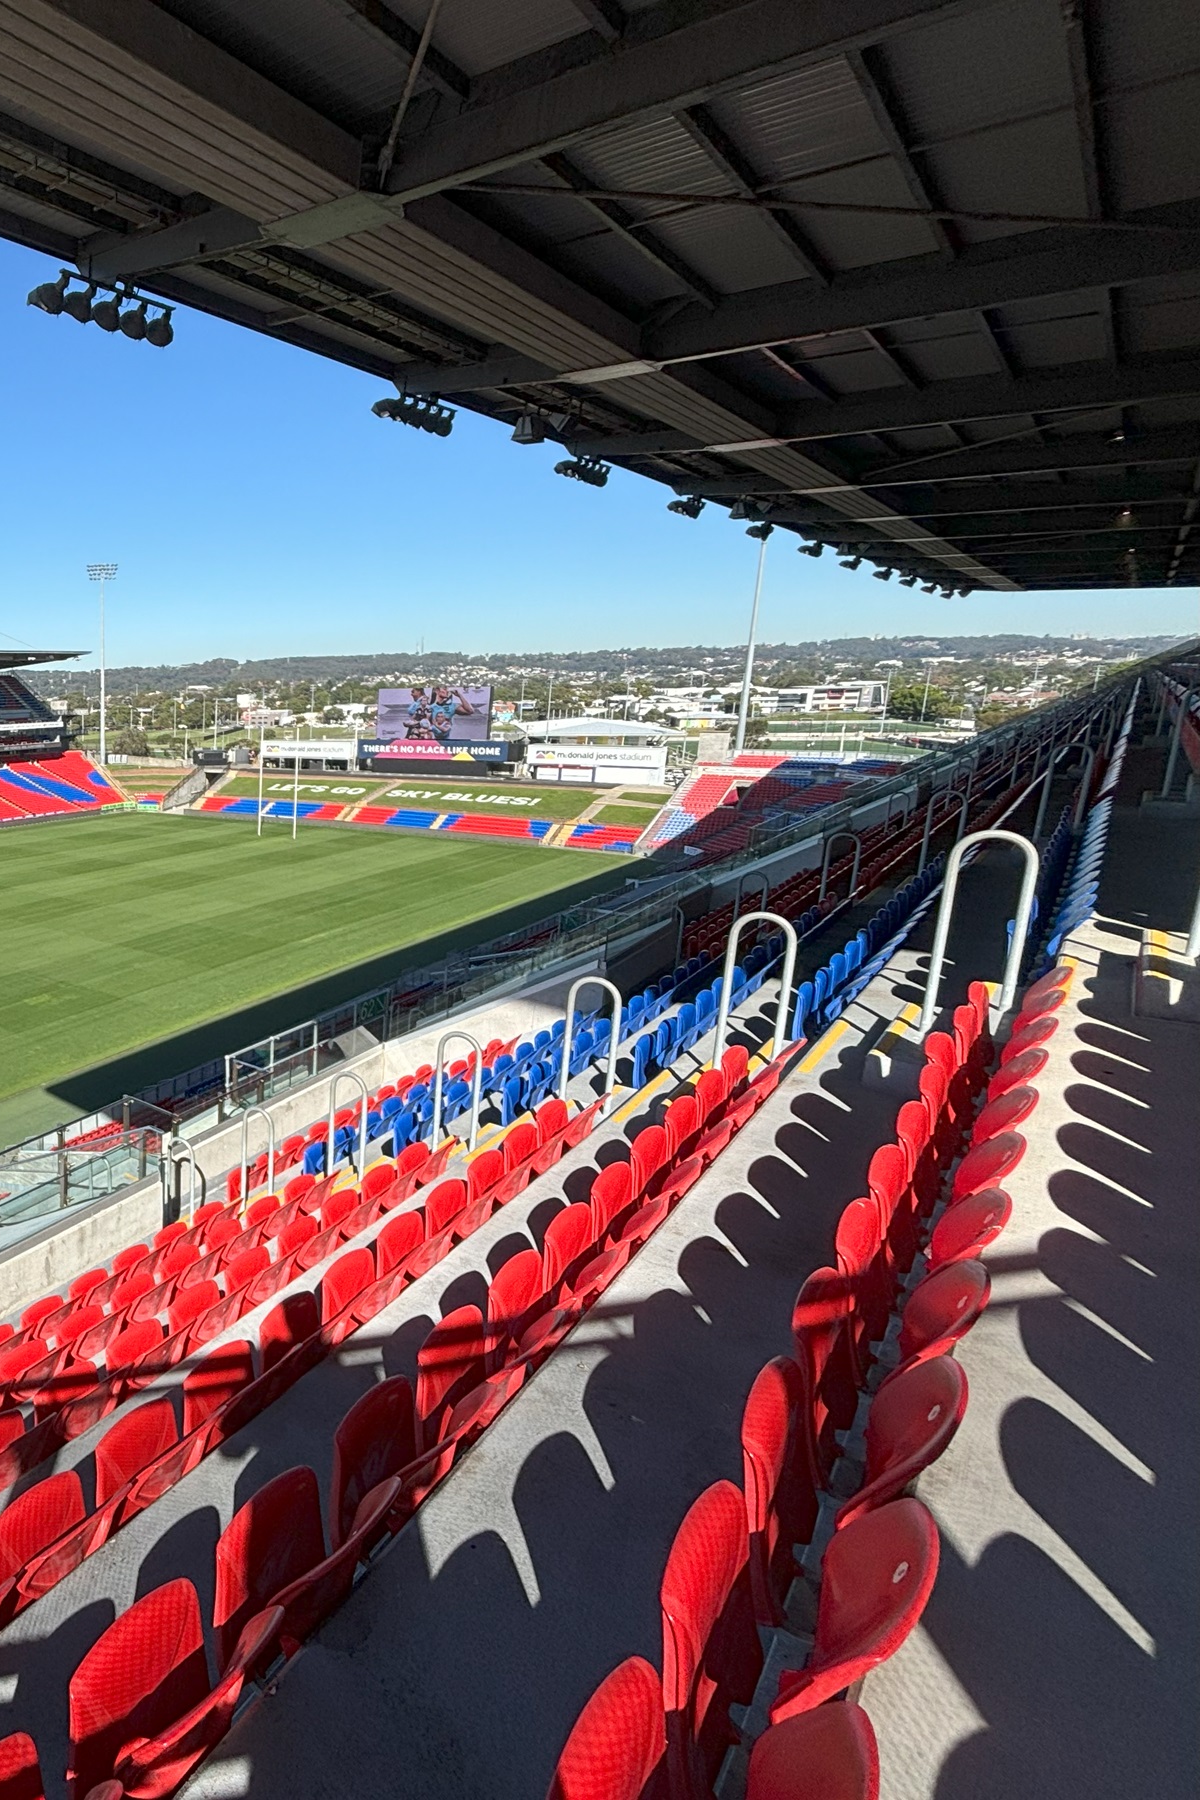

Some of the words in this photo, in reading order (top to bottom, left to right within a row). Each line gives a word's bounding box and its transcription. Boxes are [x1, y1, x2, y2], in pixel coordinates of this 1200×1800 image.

[362, 744, 399, 753] THERE'S
[400, 745, 415, 754] NO
[416, 745, 445, 755] PLACE
[447, 746, 468, 756] LIKE
[470, 747, 502, 756] HOME
[595, 751, 618, 761] jones
[619, 752, 652, 761] stadium
[267, 783, 330, 793] LET'S
[330, 786, 367, 795] GO
[386, 789, 442, 799] SKY
[440, 792, 543, 807] BLUES!
